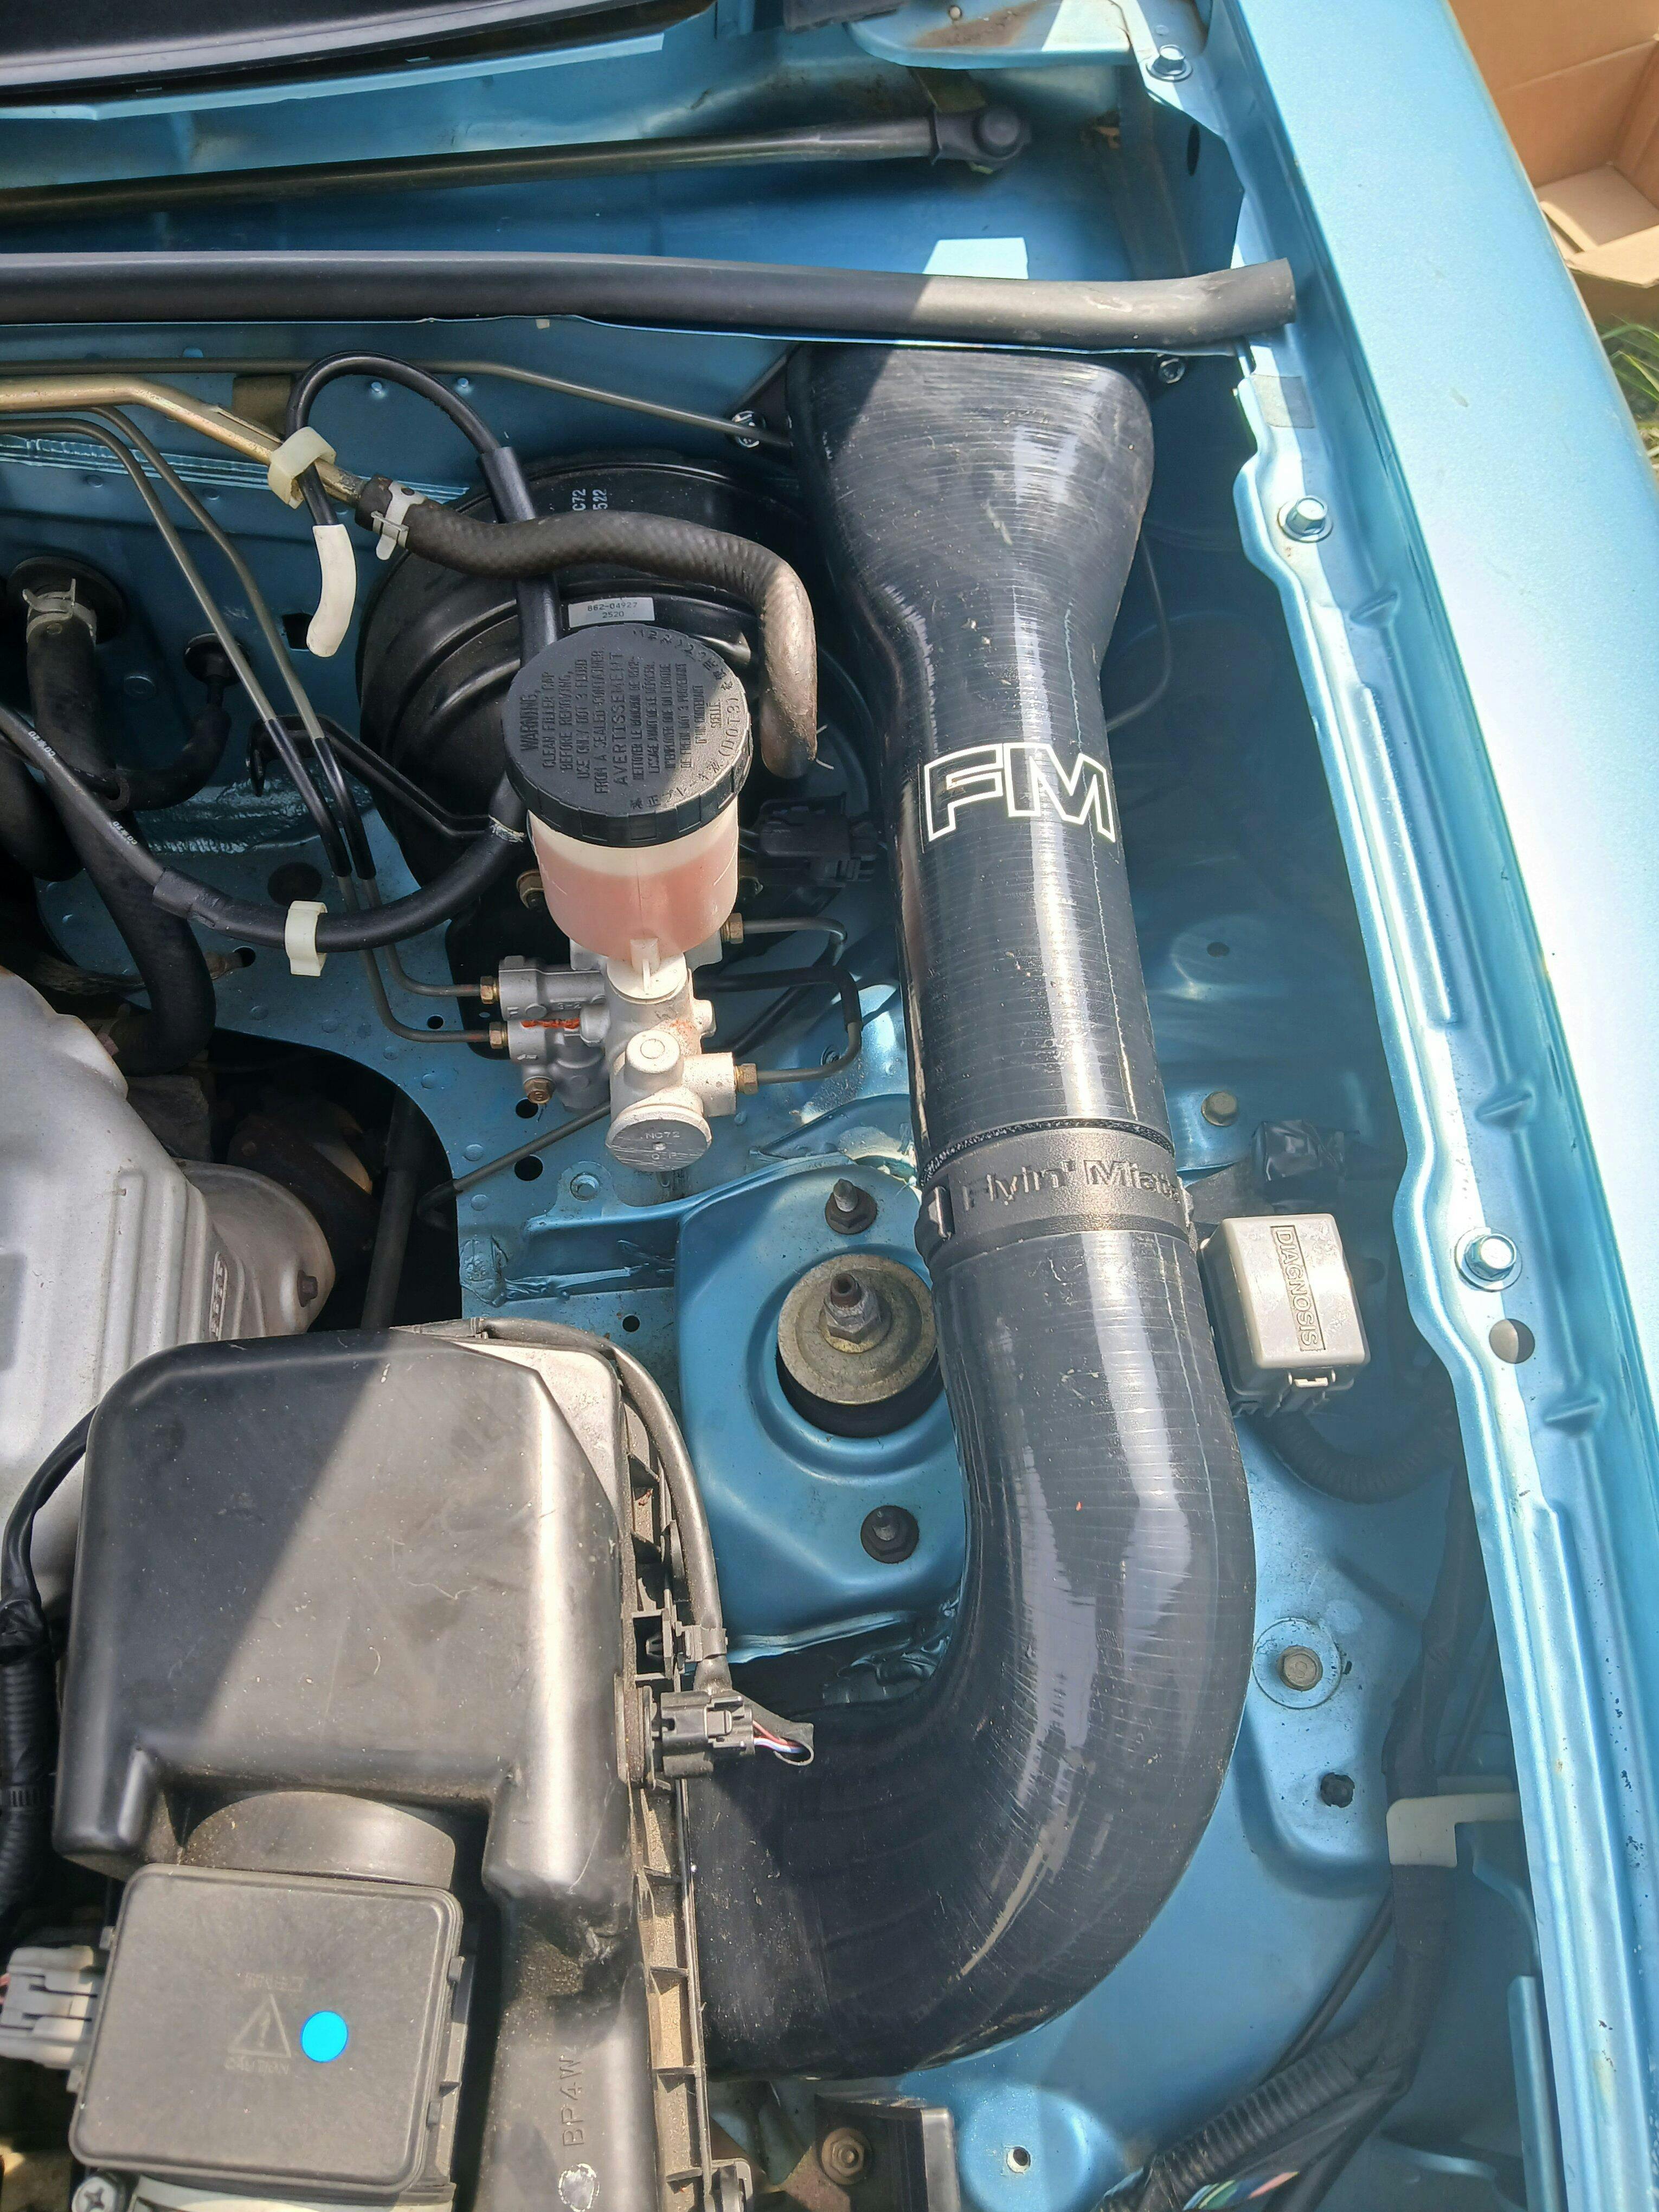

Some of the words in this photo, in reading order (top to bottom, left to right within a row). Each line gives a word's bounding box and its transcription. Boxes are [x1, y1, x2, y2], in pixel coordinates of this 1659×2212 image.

[572, 488, 587, 511] C72
[593, 488, 608, 510] 522
[587, 602, 638, 612] 862-04927
[602, 610, 624, 619] 2520
[542, 671, 554, 690] CAP
[575, 659, 587, 687] FLUID
[542, 697, 555, 730] FILLER
[576, 706, 588, 723] DOT
[609, 651, 628, 785] AVERTISSEMENT
[576, 729, 589, 753] ONLY
[593, 710, 606, 747] SEALED
[631, 731, 642, 739] LE
[542, 736, 556, 768] CLEAN
[560, 732, 573, 770] BEFORE
[680, 758, 692, 768] DE
[577, 760, 589, 778] USE
[594, 767, 608, 793] FROM
[924, 742, 1116, 843] FM
[1276, 1230, 1319, 1347] DIAGNOSIS
[559, 2058, 584, 2146] BP4W
